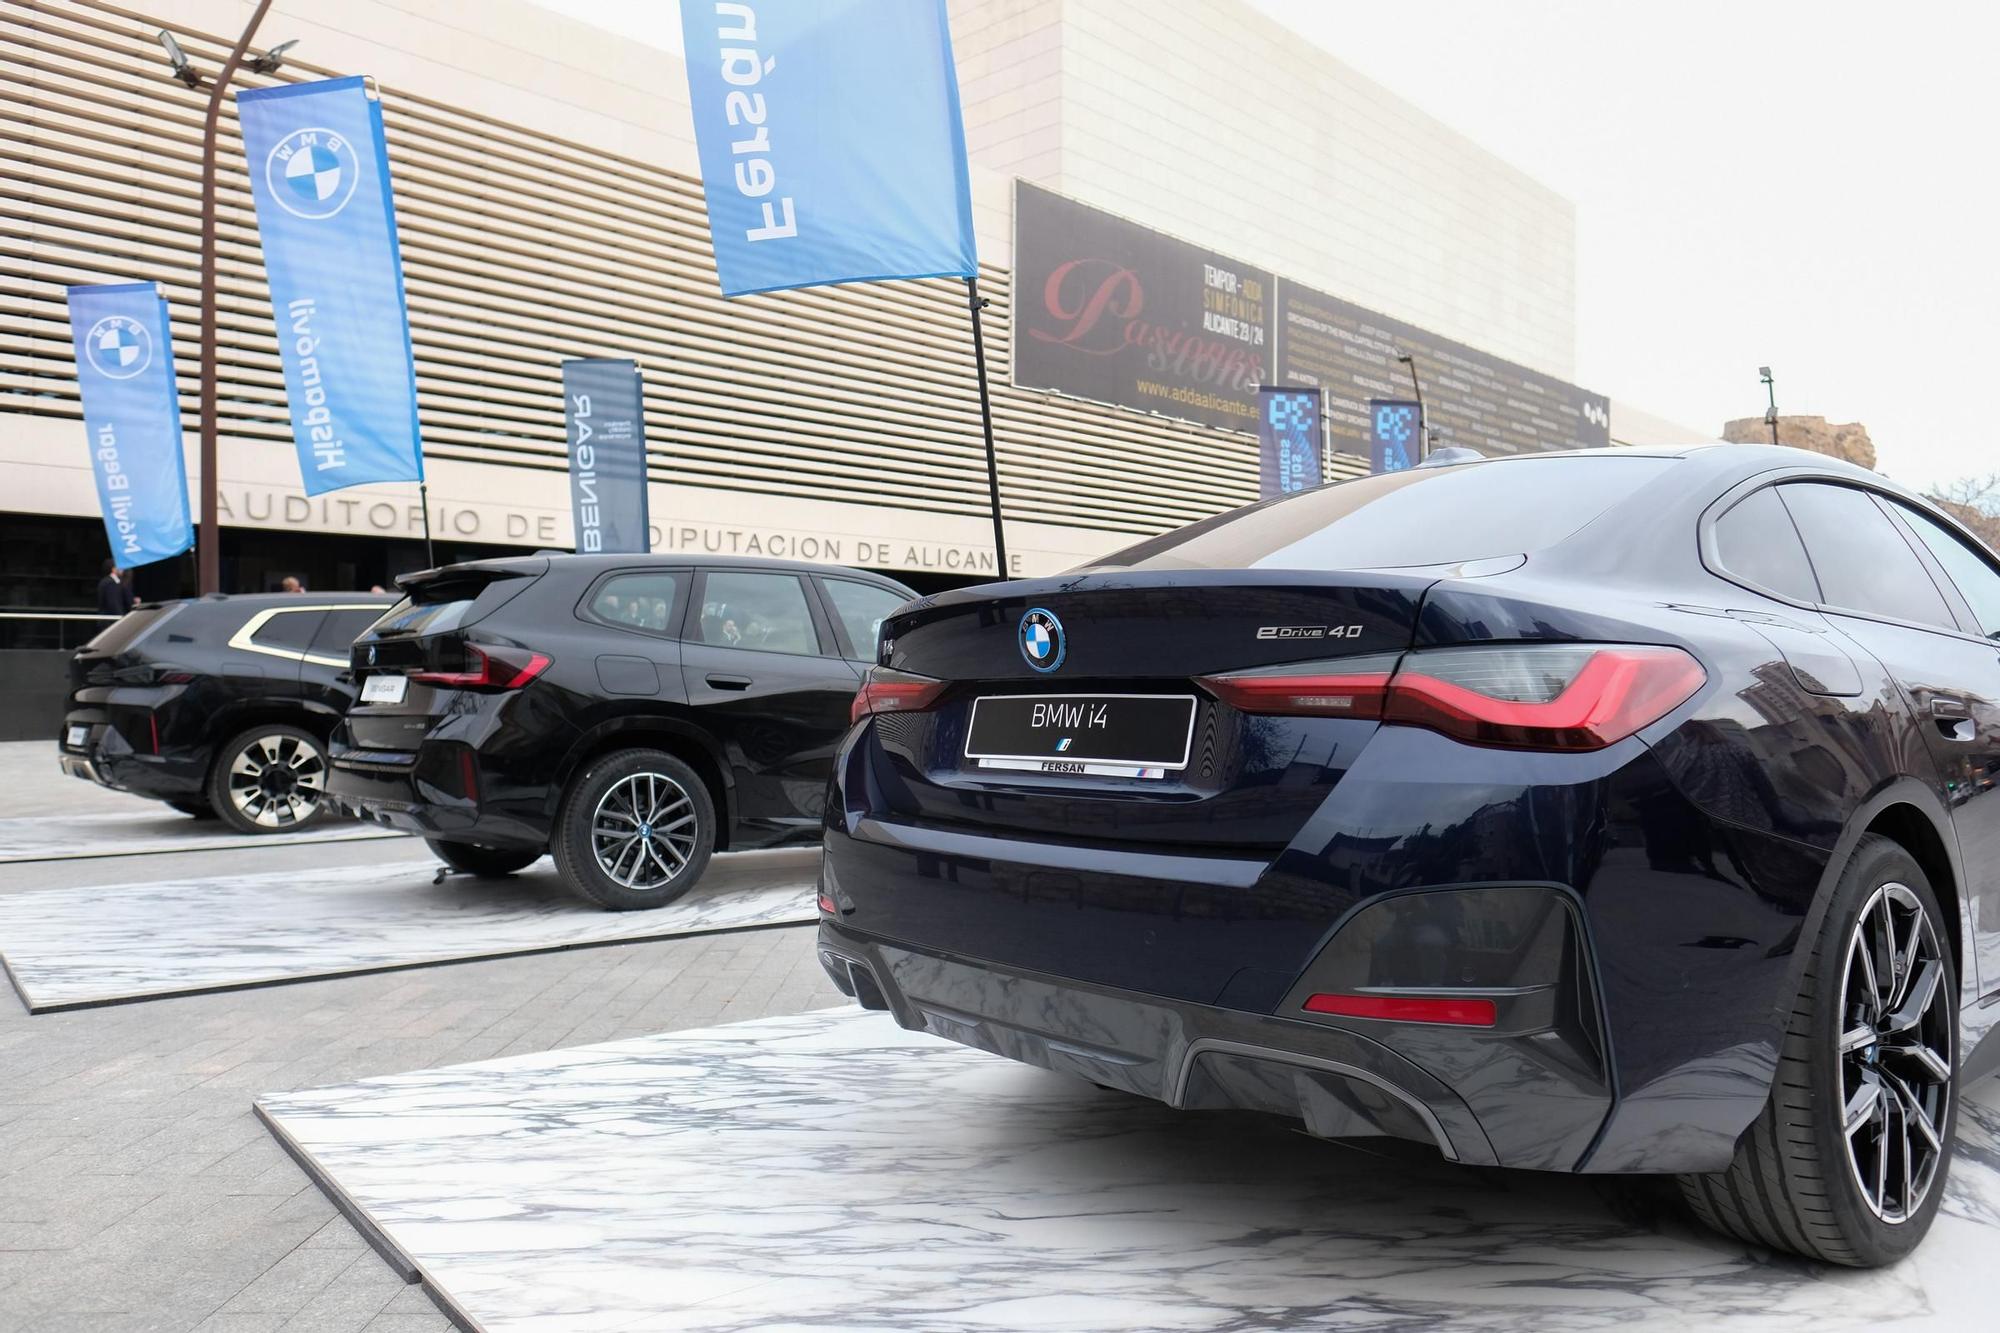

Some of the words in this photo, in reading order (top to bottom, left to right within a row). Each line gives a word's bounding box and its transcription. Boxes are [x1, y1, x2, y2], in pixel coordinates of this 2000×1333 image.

[1204, 264, 1237, 294] TEMPOR
[1203, 311, 1239, 338] ALICANTE
[507, 513, 557, 541] DE
[857, 542, 890, 564] DE
[904, 546, 1022, 573] ALICANE
[1022, 613, 1055, 632] BMW
[1256, 626, 1325, 639] eDrive
[1328, 625, 1363, 638] 40
[1031, 703, 1085, 728] BMW
[1088, 703, 1108, 729] i4
[1041, 762, 1086, 773] FERSAN
